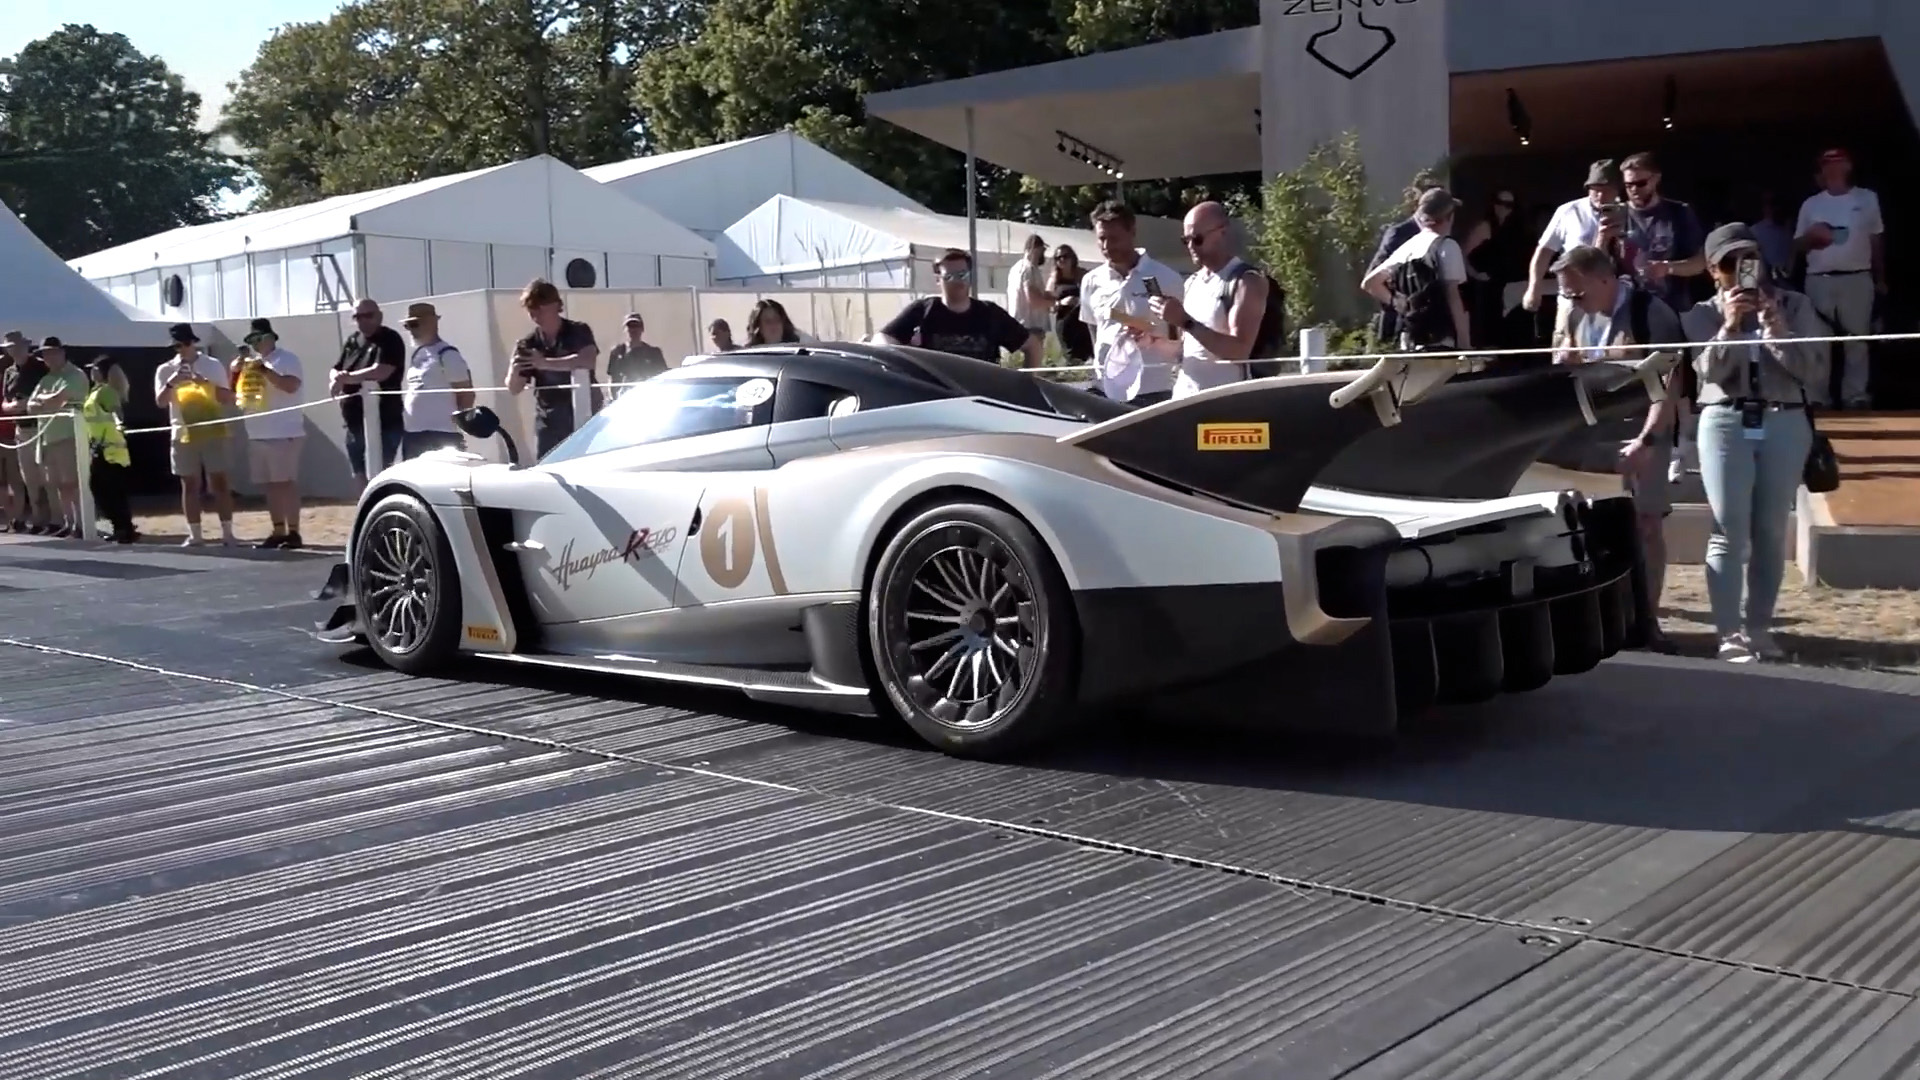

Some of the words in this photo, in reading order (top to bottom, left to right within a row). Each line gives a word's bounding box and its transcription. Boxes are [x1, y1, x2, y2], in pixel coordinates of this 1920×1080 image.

[1282, 0, 1419, 15] ZEN
[1203, 428, 1263, 444] PIRELLI
[717, 514, 734, 571] 1
[552, 537, 622, 591] Huayra
